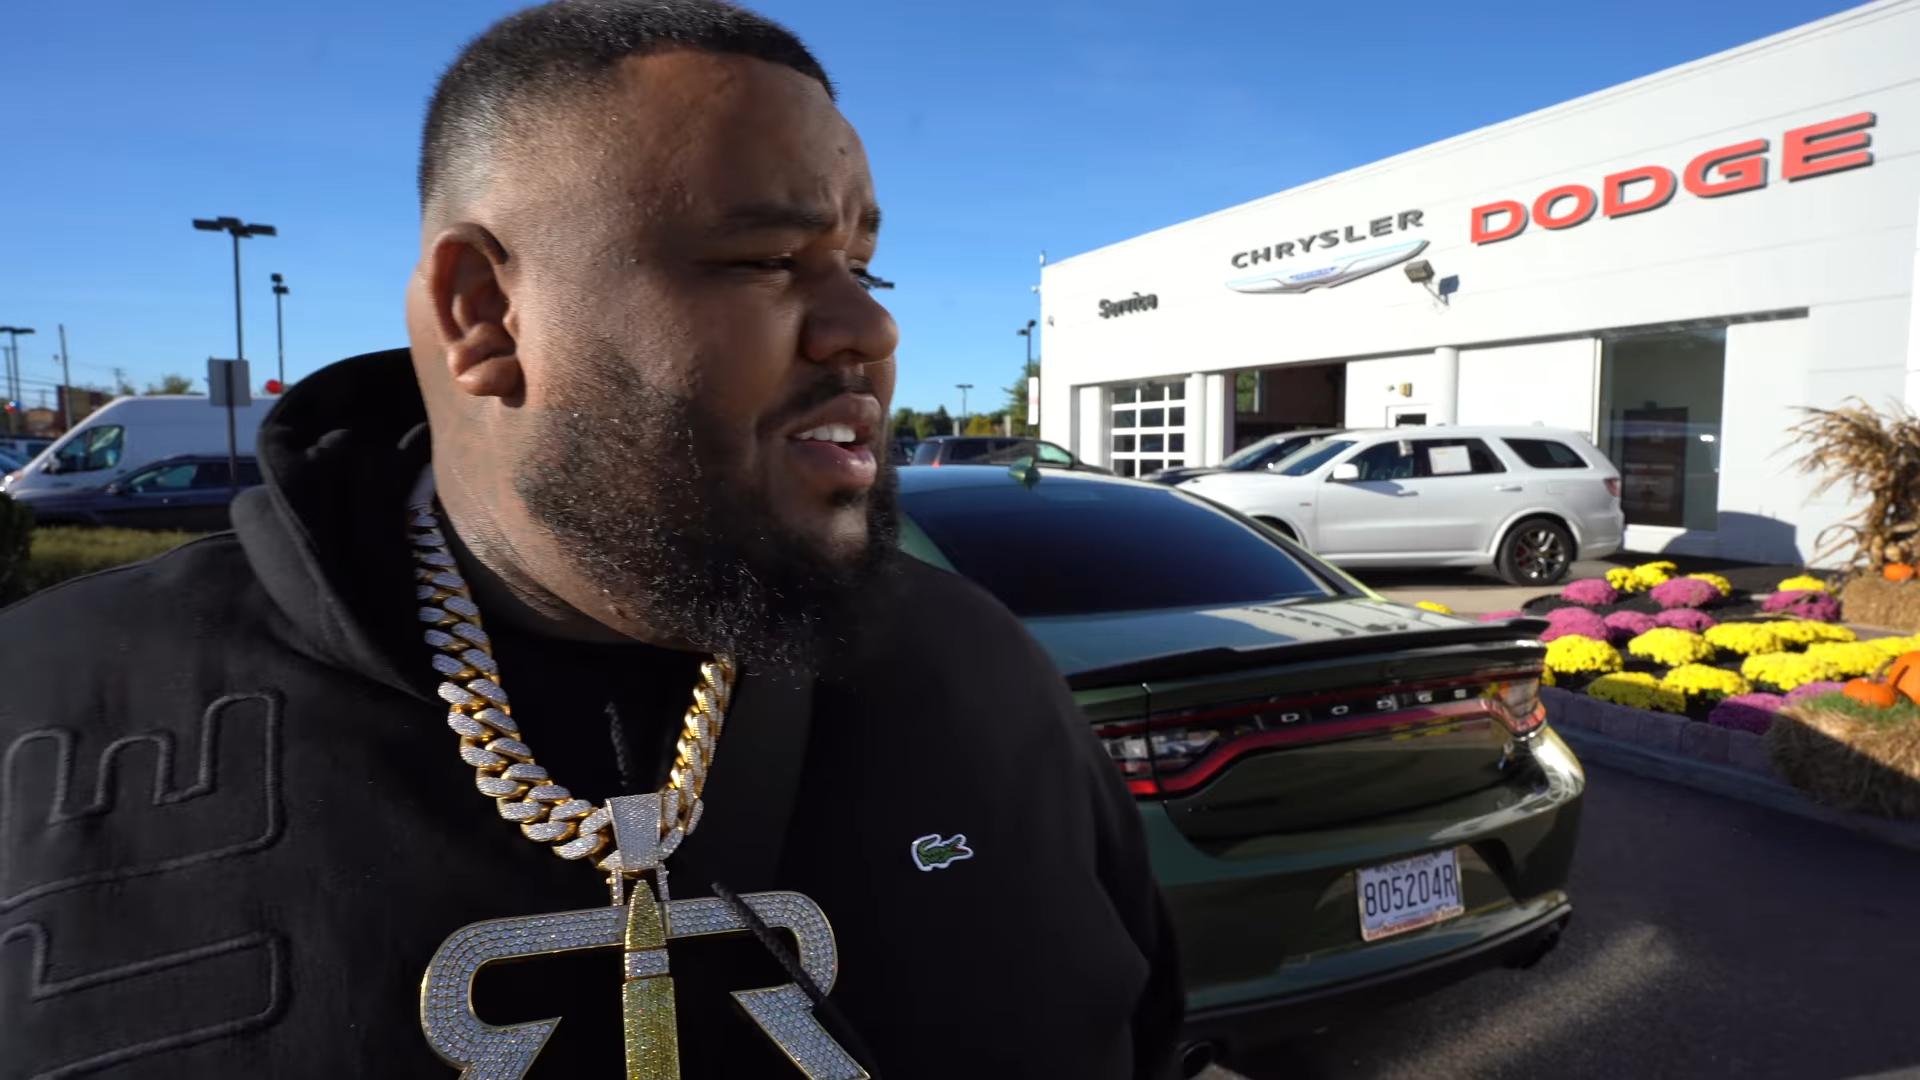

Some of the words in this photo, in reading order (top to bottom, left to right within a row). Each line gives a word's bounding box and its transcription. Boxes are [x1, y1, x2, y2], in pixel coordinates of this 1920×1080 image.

[1470, 111, 1877, 246] DODGE
[1231, 209, 1425, 269] CHRYSLER
[1098, 291, 1159, 320] Service
[1281, 688, 1468, 723] DODGE
[1364, 863, 1457, 918] 805204R
